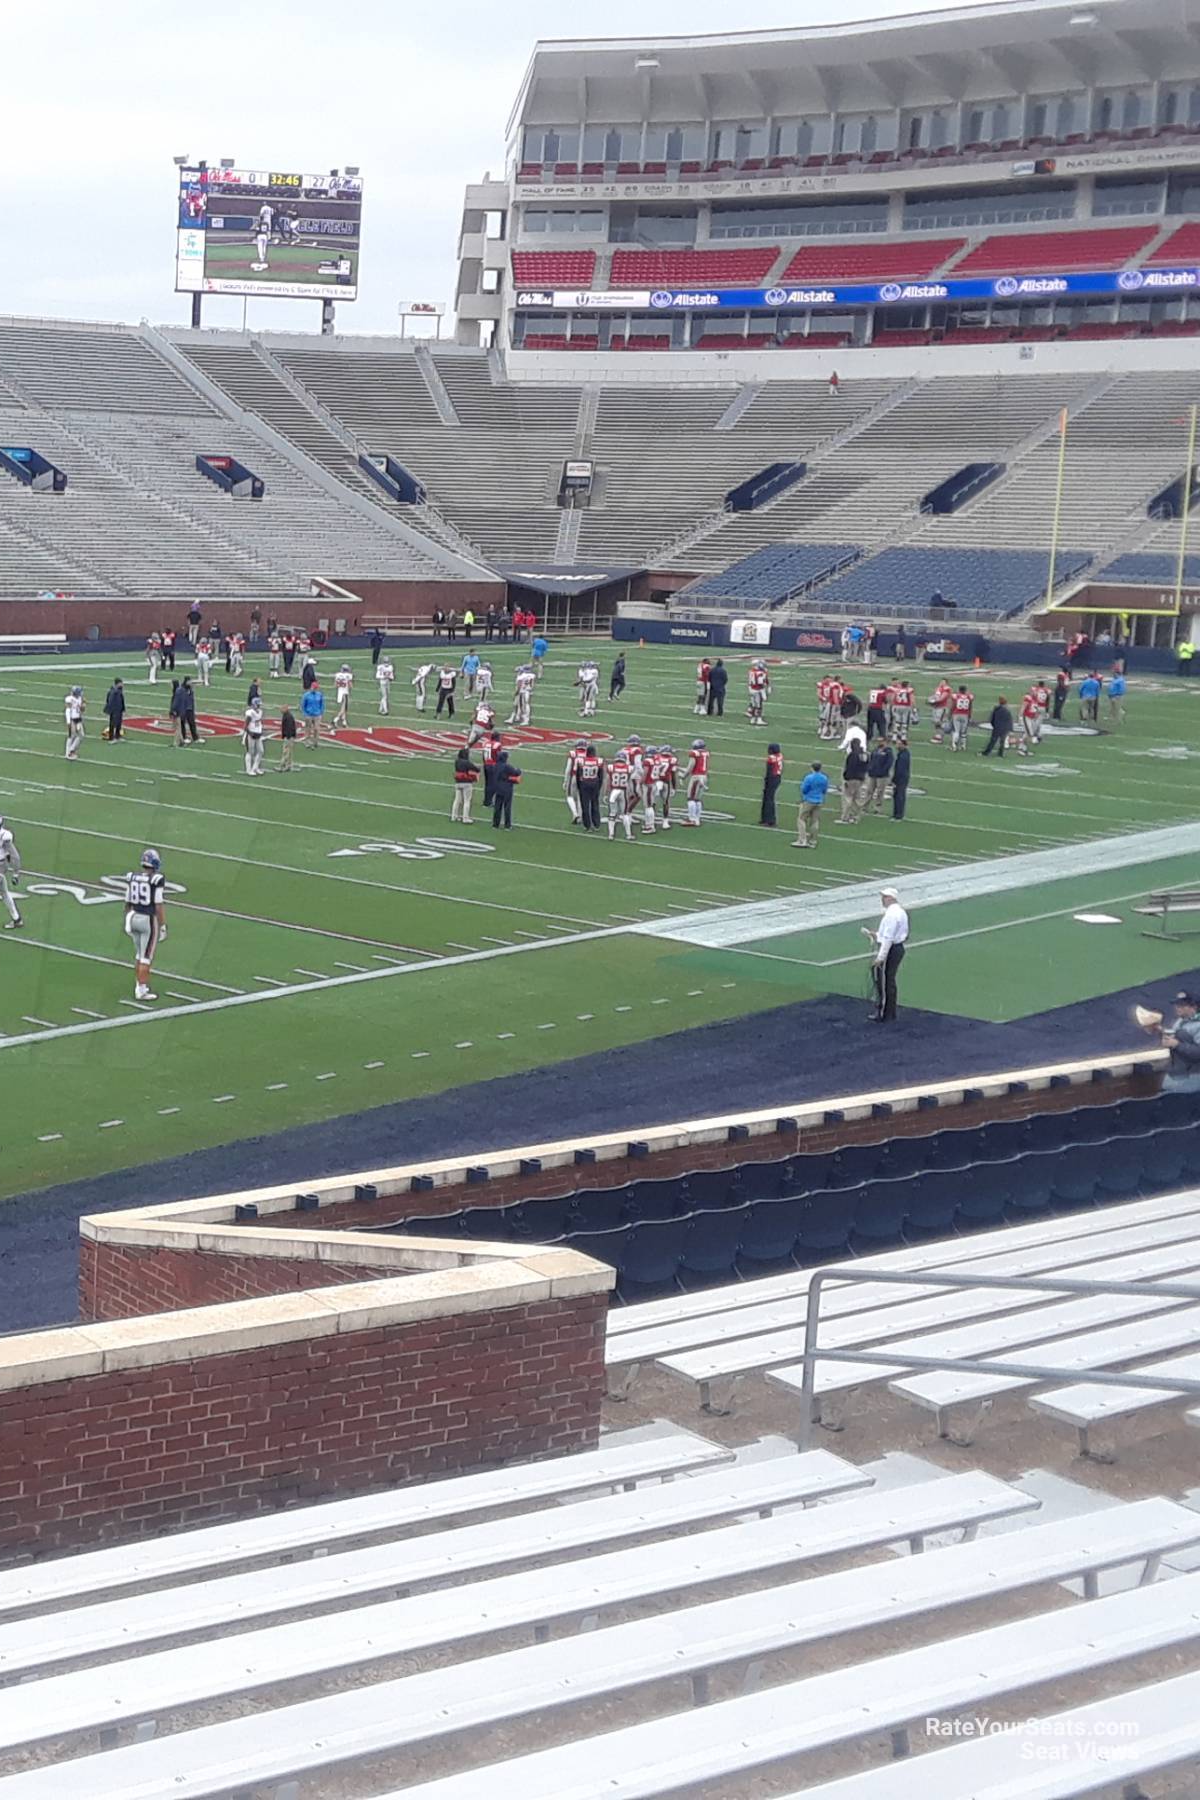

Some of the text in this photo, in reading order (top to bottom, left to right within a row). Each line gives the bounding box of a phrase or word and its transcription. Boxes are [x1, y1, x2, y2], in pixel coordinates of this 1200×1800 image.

[1066, 155, 1133, 170] NATIONAL
[270, 174, 300, 187] 32:46
[312, 176, 325, 188] 27
[1017, 278, 1068, 293] Allstate
[1142, 272, 1197, 287] Allstate
[786, 290, 836, 304] Allstate
[900, 284, 949, 299] Allstate
[672, 294, 720, 306] Allstate
[671, 627, 709, 639] NISSAN
[926, 639, 961, 654] edEx
[581, 764, 600, 780] 80
[612, 771, 629, 788] 82
[130, 880, 152, 906] 89
